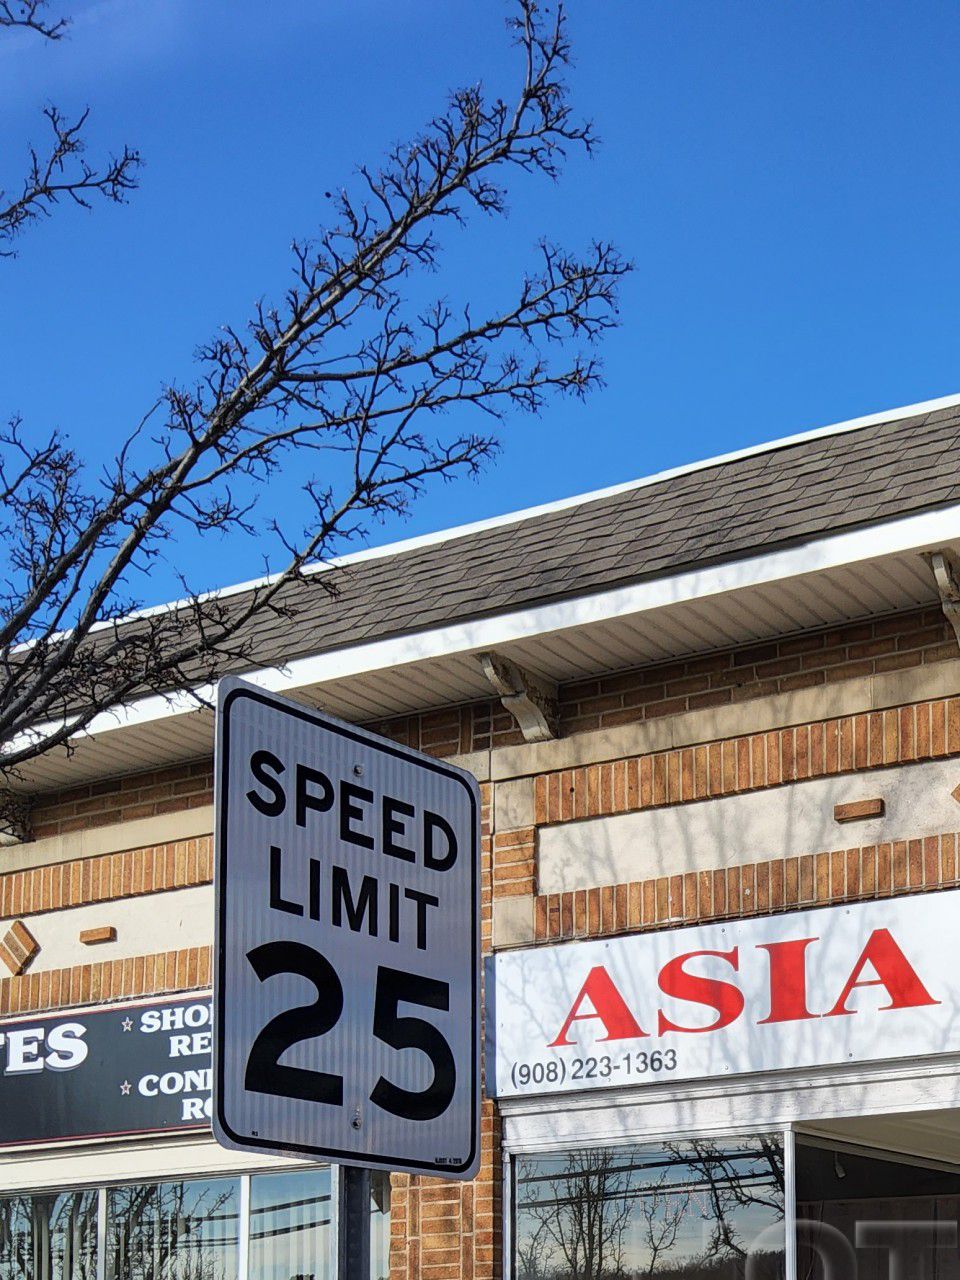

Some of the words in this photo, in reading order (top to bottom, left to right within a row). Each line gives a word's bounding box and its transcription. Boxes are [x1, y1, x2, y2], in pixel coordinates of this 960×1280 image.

[245, 749, 458, 873] SPEED
[269, 845, 439, 951] LIMIT
[140, 1003, 212, 1033] SHO
[244, 940, 457, 1122] 25
[546, 928, 943, 1048] ASIA
[0, 1022, 89, 1075] ES
[511, 1060, 567, 1090] (908)
[571, 1048, 678, 1083] 223-1363
